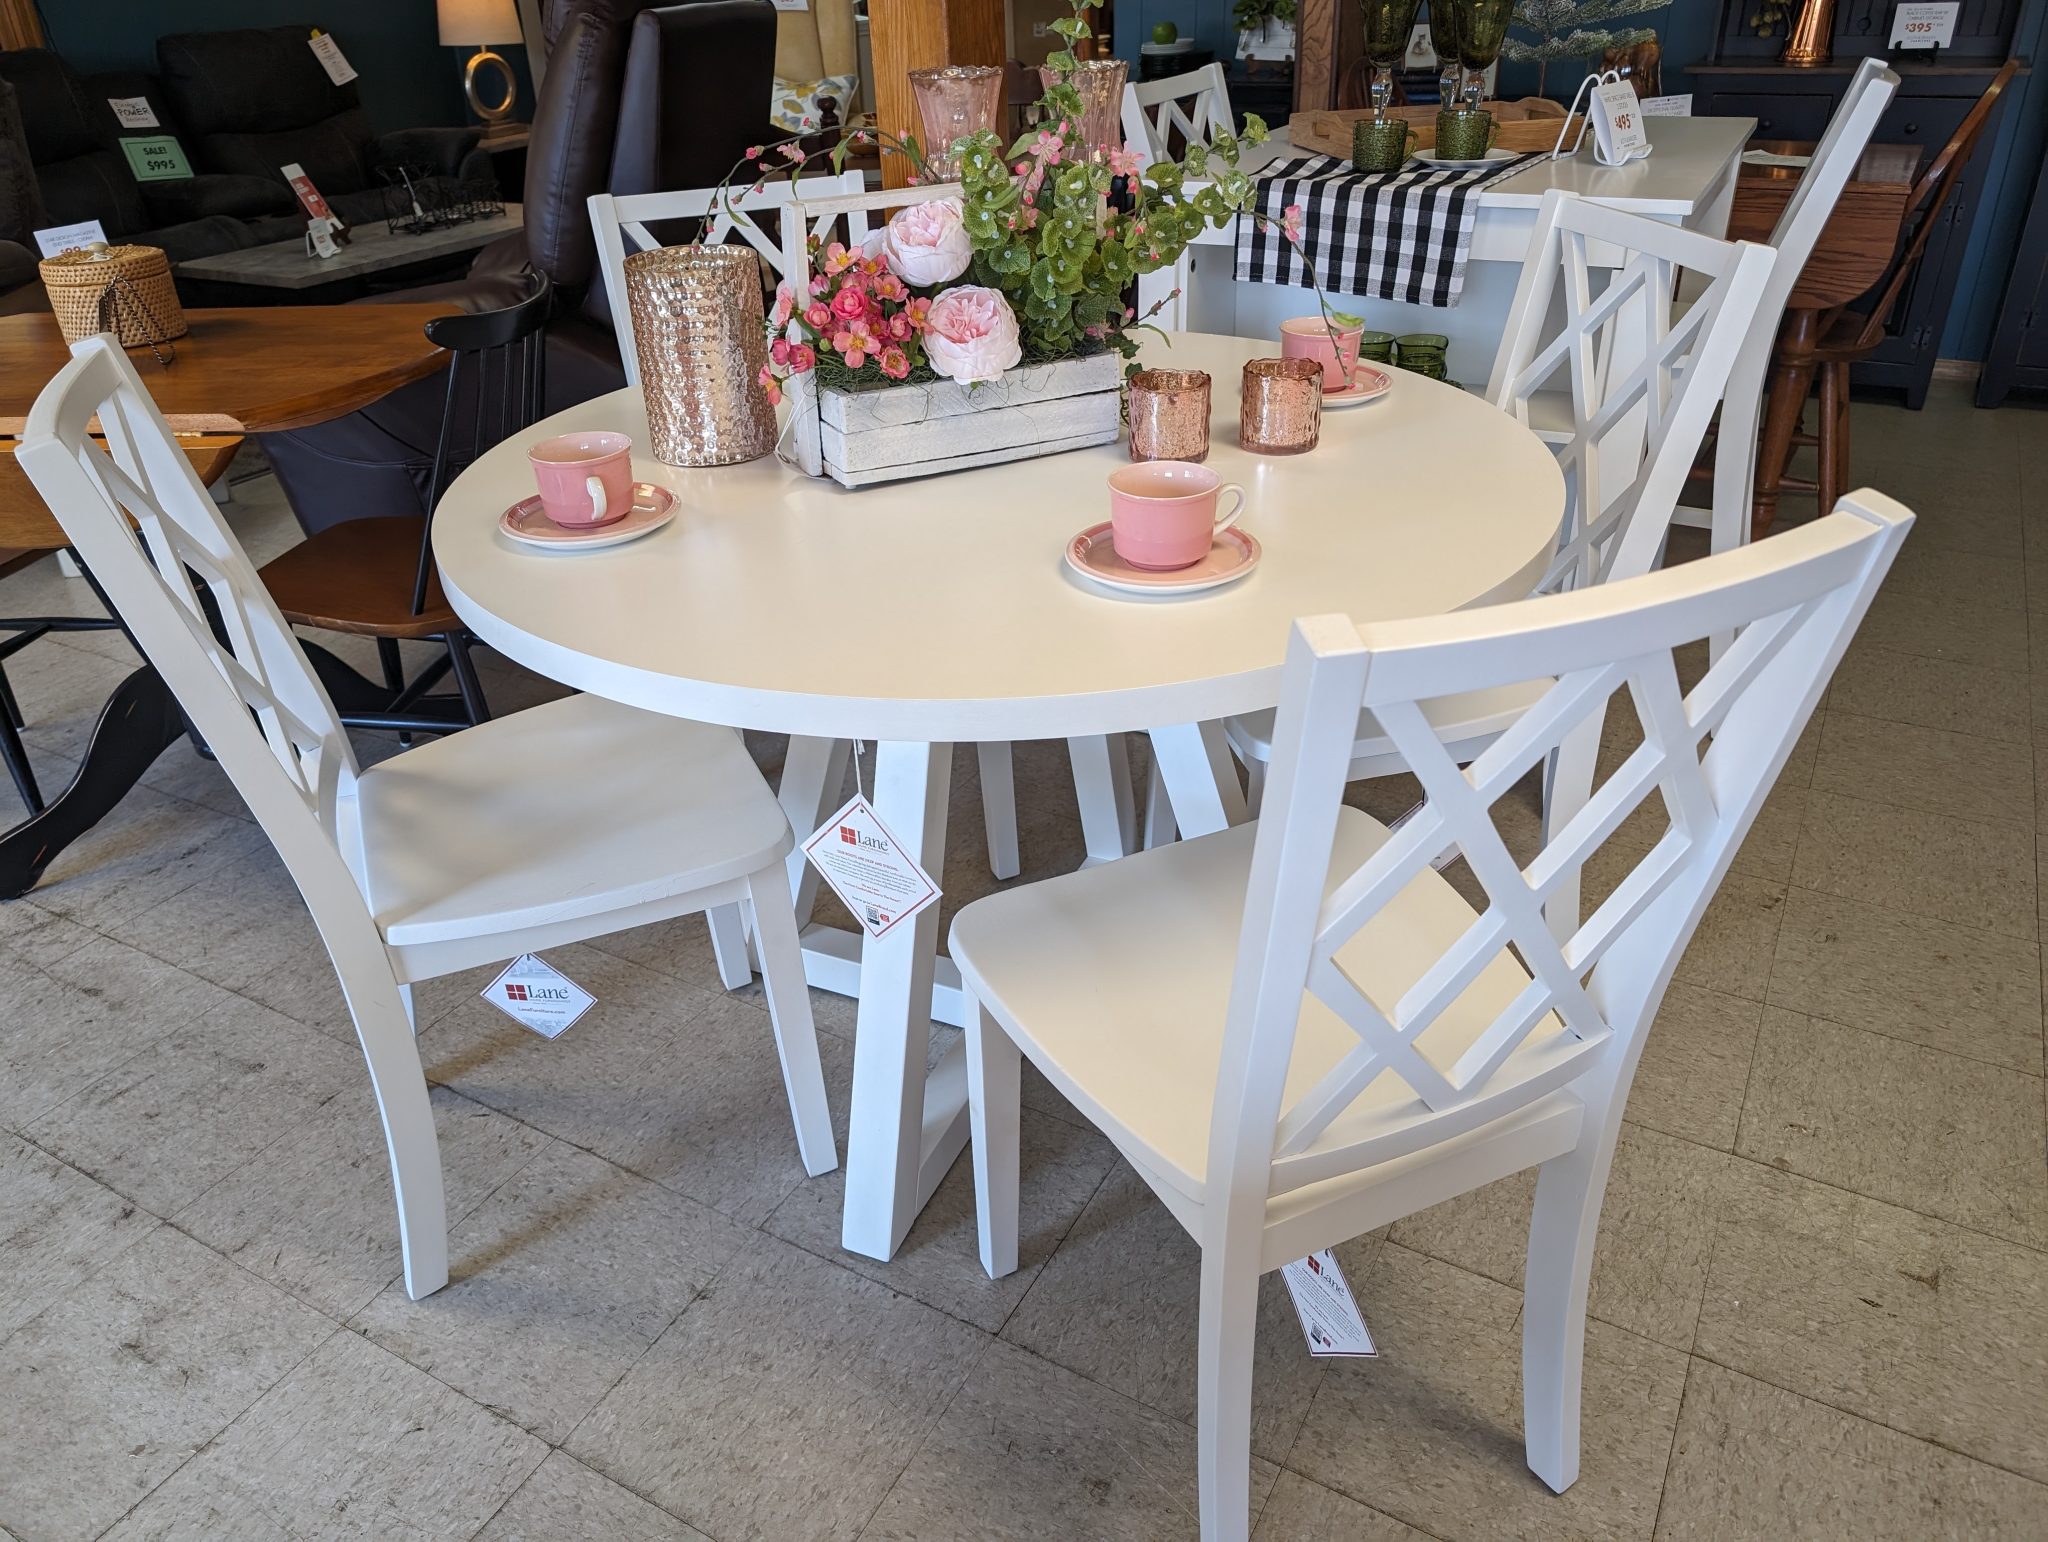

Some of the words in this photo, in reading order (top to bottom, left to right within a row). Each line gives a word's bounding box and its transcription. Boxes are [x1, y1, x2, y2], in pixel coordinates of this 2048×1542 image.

[1905, 22, 1932, 32] $395
[117, 106, 150, 116] POWER
[1615, 114, 1631, 130] $495
[143, 147, 167, 155] SALE!
[147, 160, 176, 171] $995
[857, 830, 889, 851] Lane
[526, 985, 569, 999] Lane
[1320, 1266, 1345, 1296] Lane
